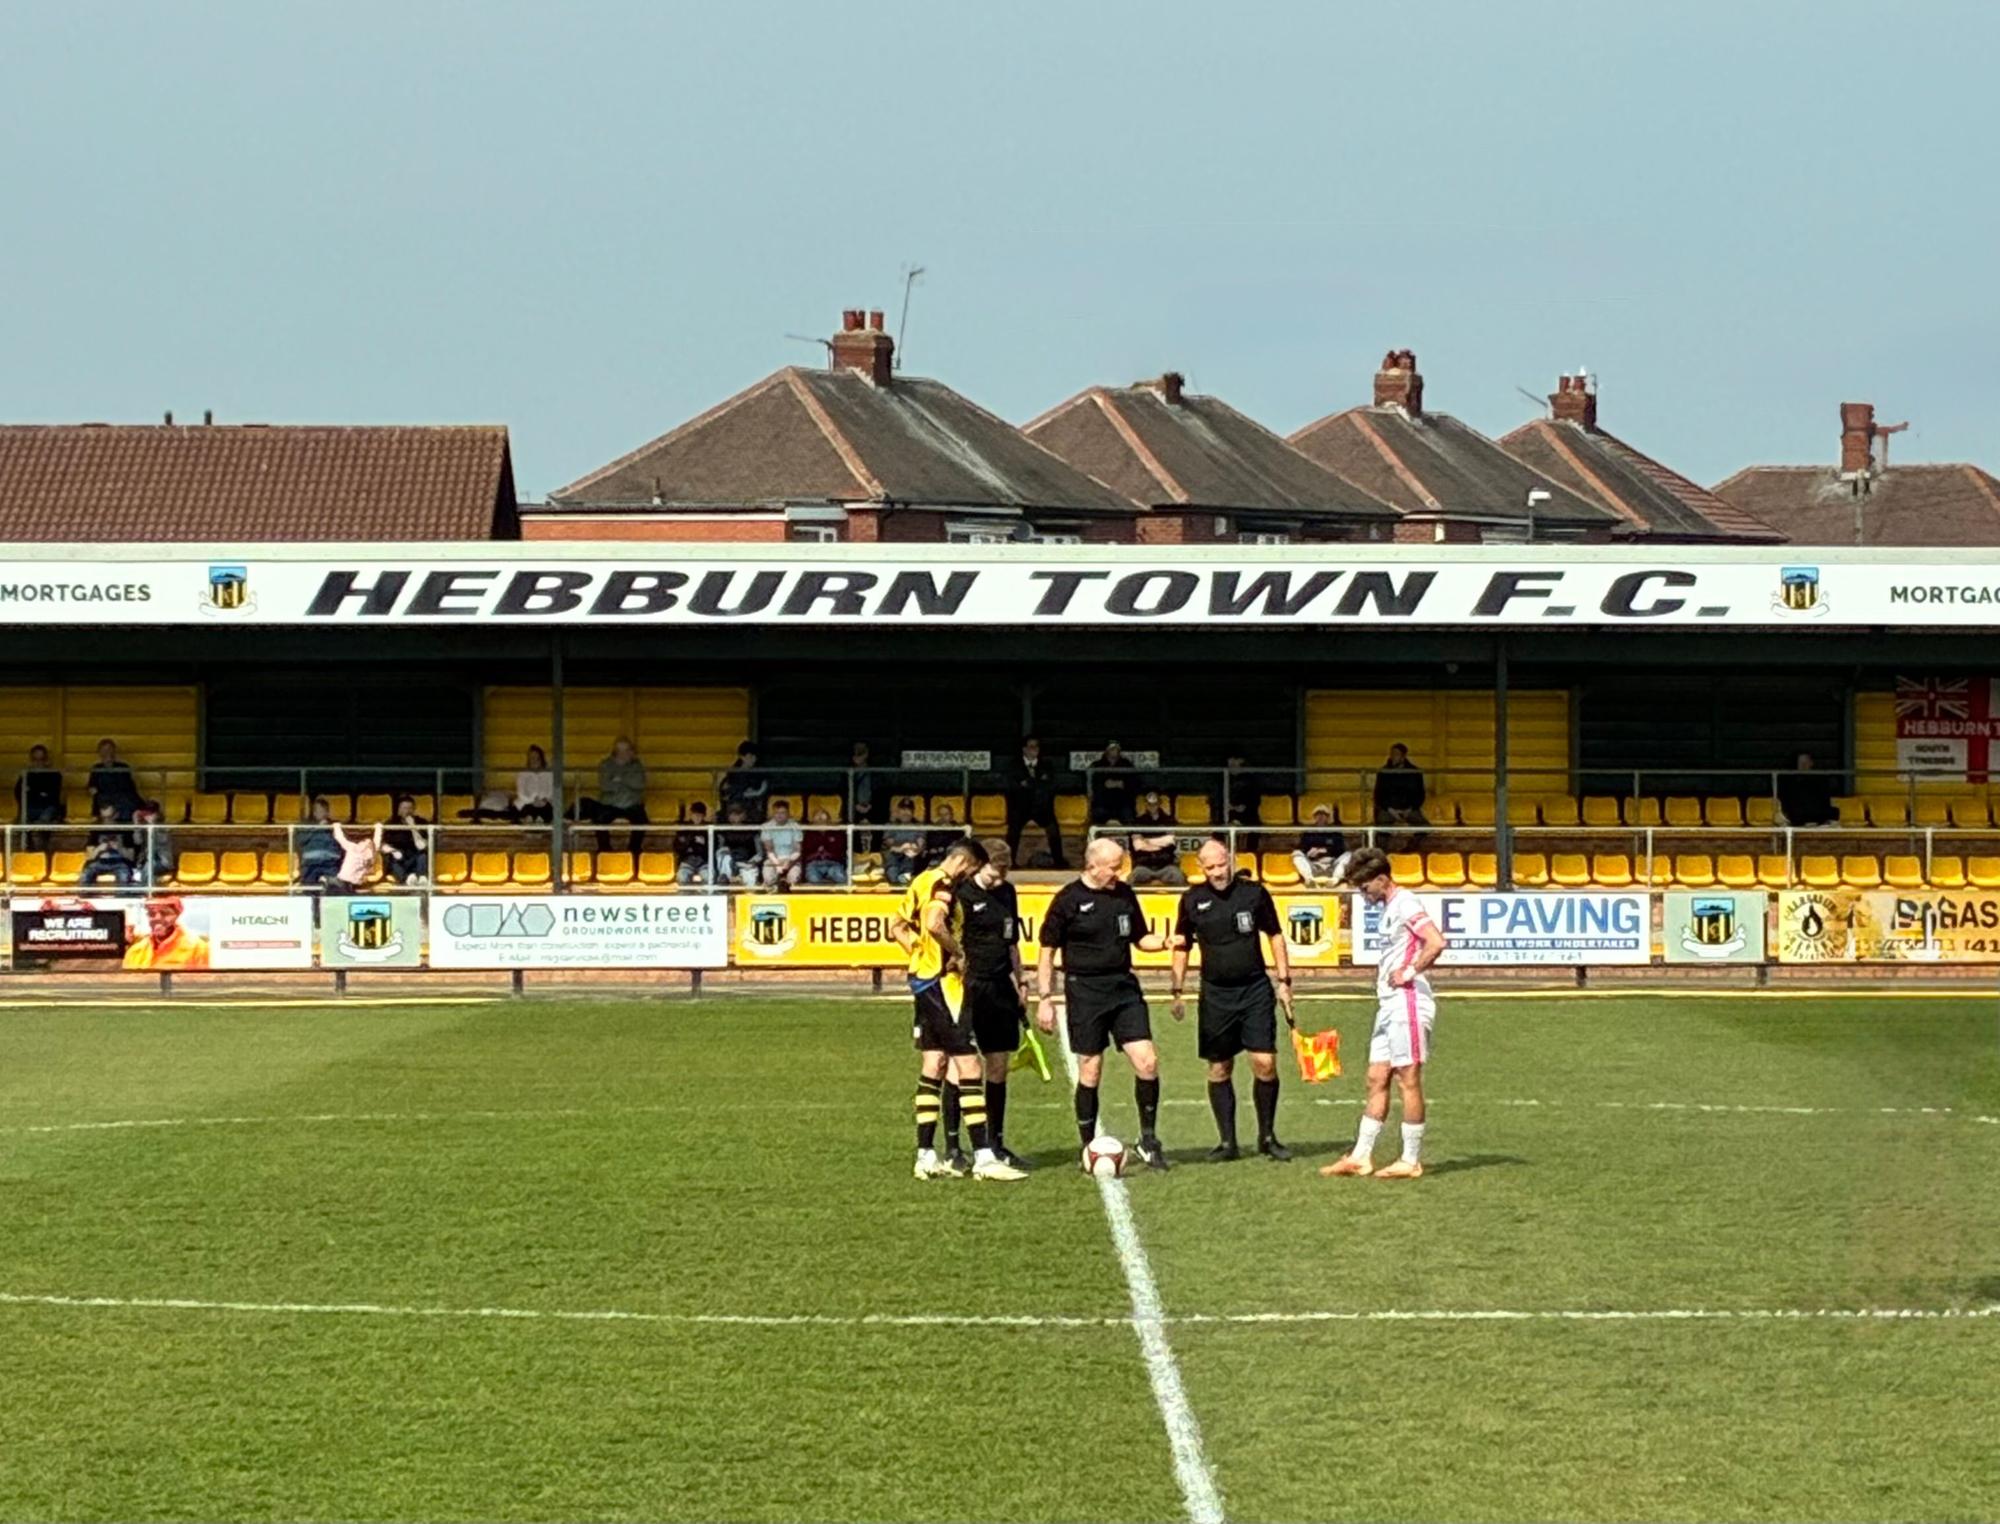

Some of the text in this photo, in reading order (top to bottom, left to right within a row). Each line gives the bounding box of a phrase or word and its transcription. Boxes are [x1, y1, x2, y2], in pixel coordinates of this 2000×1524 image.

[0, 584, 151, 602] MORTGAGES
[304, 570, 1731, 617] HEBBURN TOWN F.C.
[1903, 720, 1991, 736] HEBBURN
[232, 915, 288, 925] HITACHI
[563, 903, 711, 922] newstreet
[1480, 898, 1640, 934] PAVING
[44, 917, 65, 929] WE
[562, 926, 713, 935] GROUNDWORK SERVICES
[810, 916, 902, 943] HEBBU
[1468, 940, 1512, 949] PAVING
